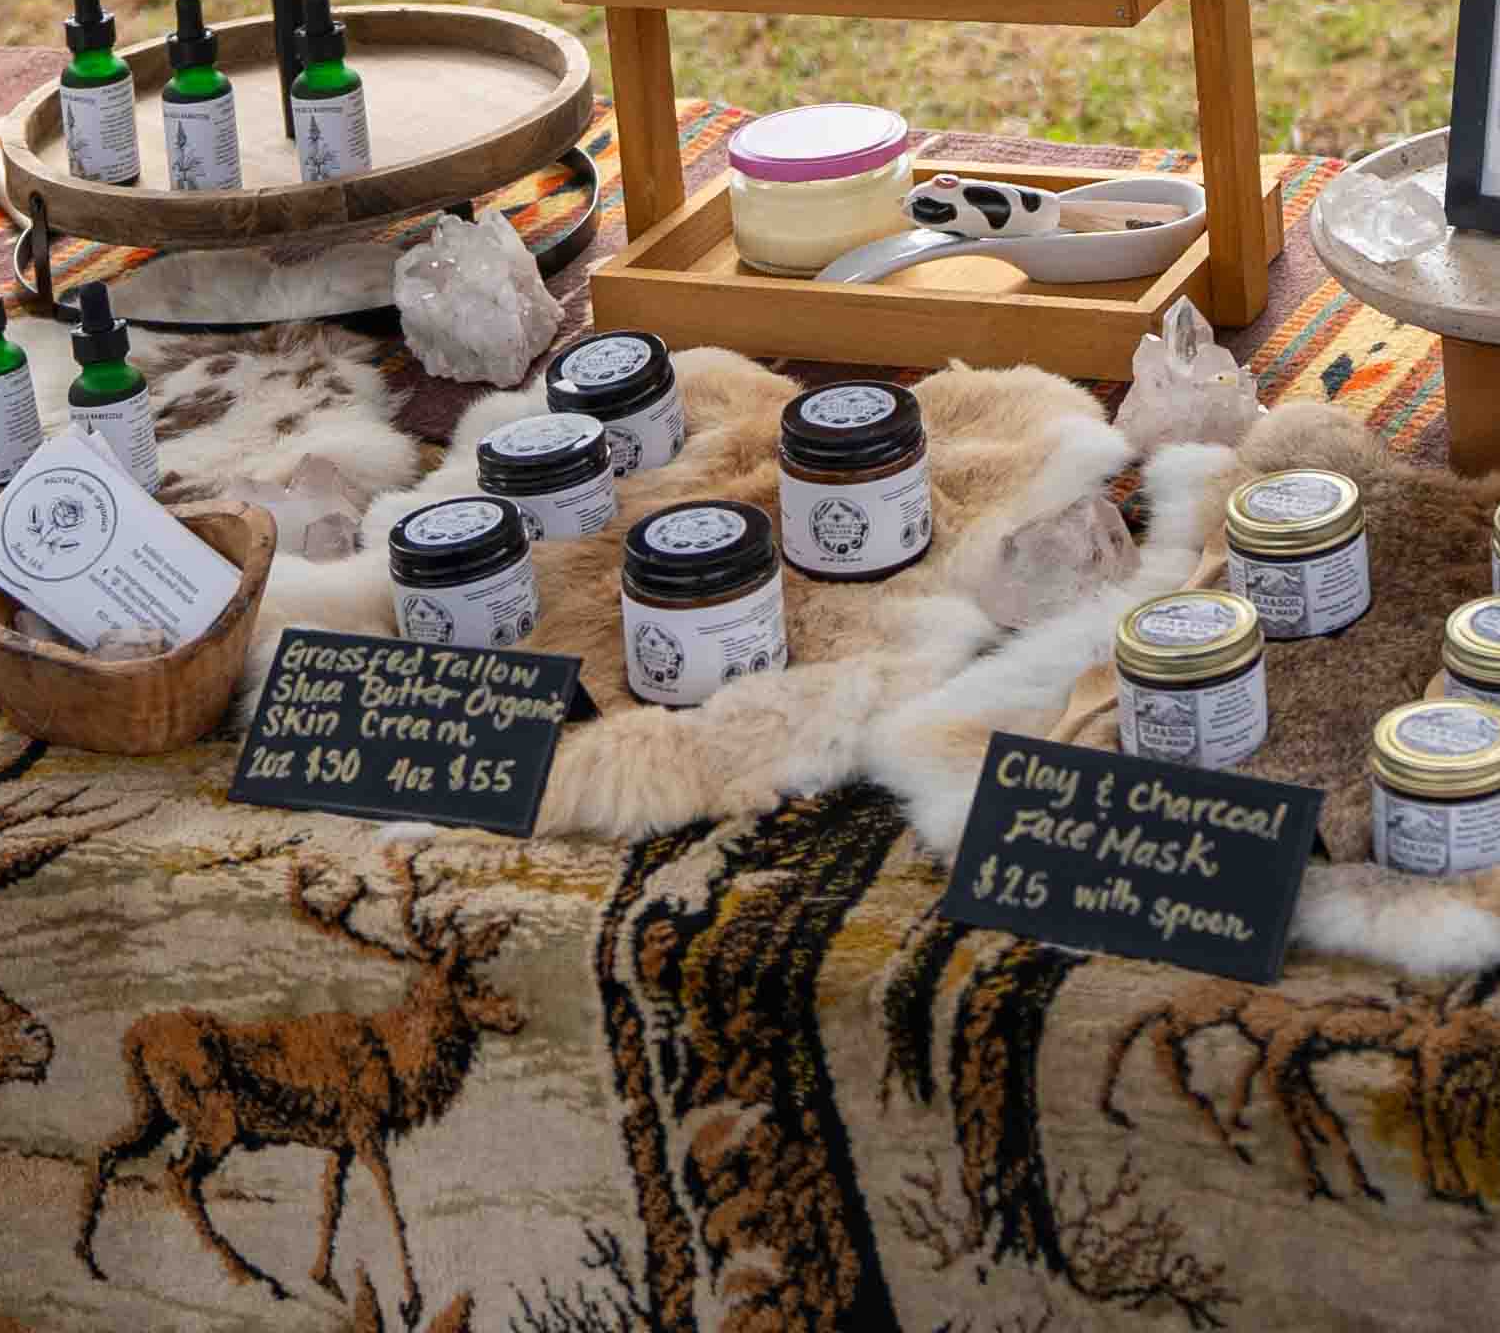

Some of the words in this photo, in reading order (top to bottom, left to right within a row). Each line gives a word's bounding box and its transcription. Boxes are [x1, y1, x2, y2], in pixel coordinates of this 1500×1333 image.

[431, 651, 540, 688] Tallow
[273, 674, 346, 702] Shea
[358, 673, 461, 710] Butter
[464, 684, 567, 731] Organic
[360, 709, 476, 747] Cream
[246, 746, 295, 780] 2oz
[305, 748, 361, 784] $30
[449, 754, 517, 793] $55
[997, 750, 1082, 808] Clay
[1004, 809, 1098, 852] Face
[1099, 827, 1220, 878] Mask
[971, 854, 1049, 910] $25
[1073, 876, 1141, 915] with
[1148, 896, 1255, 943] spoon
